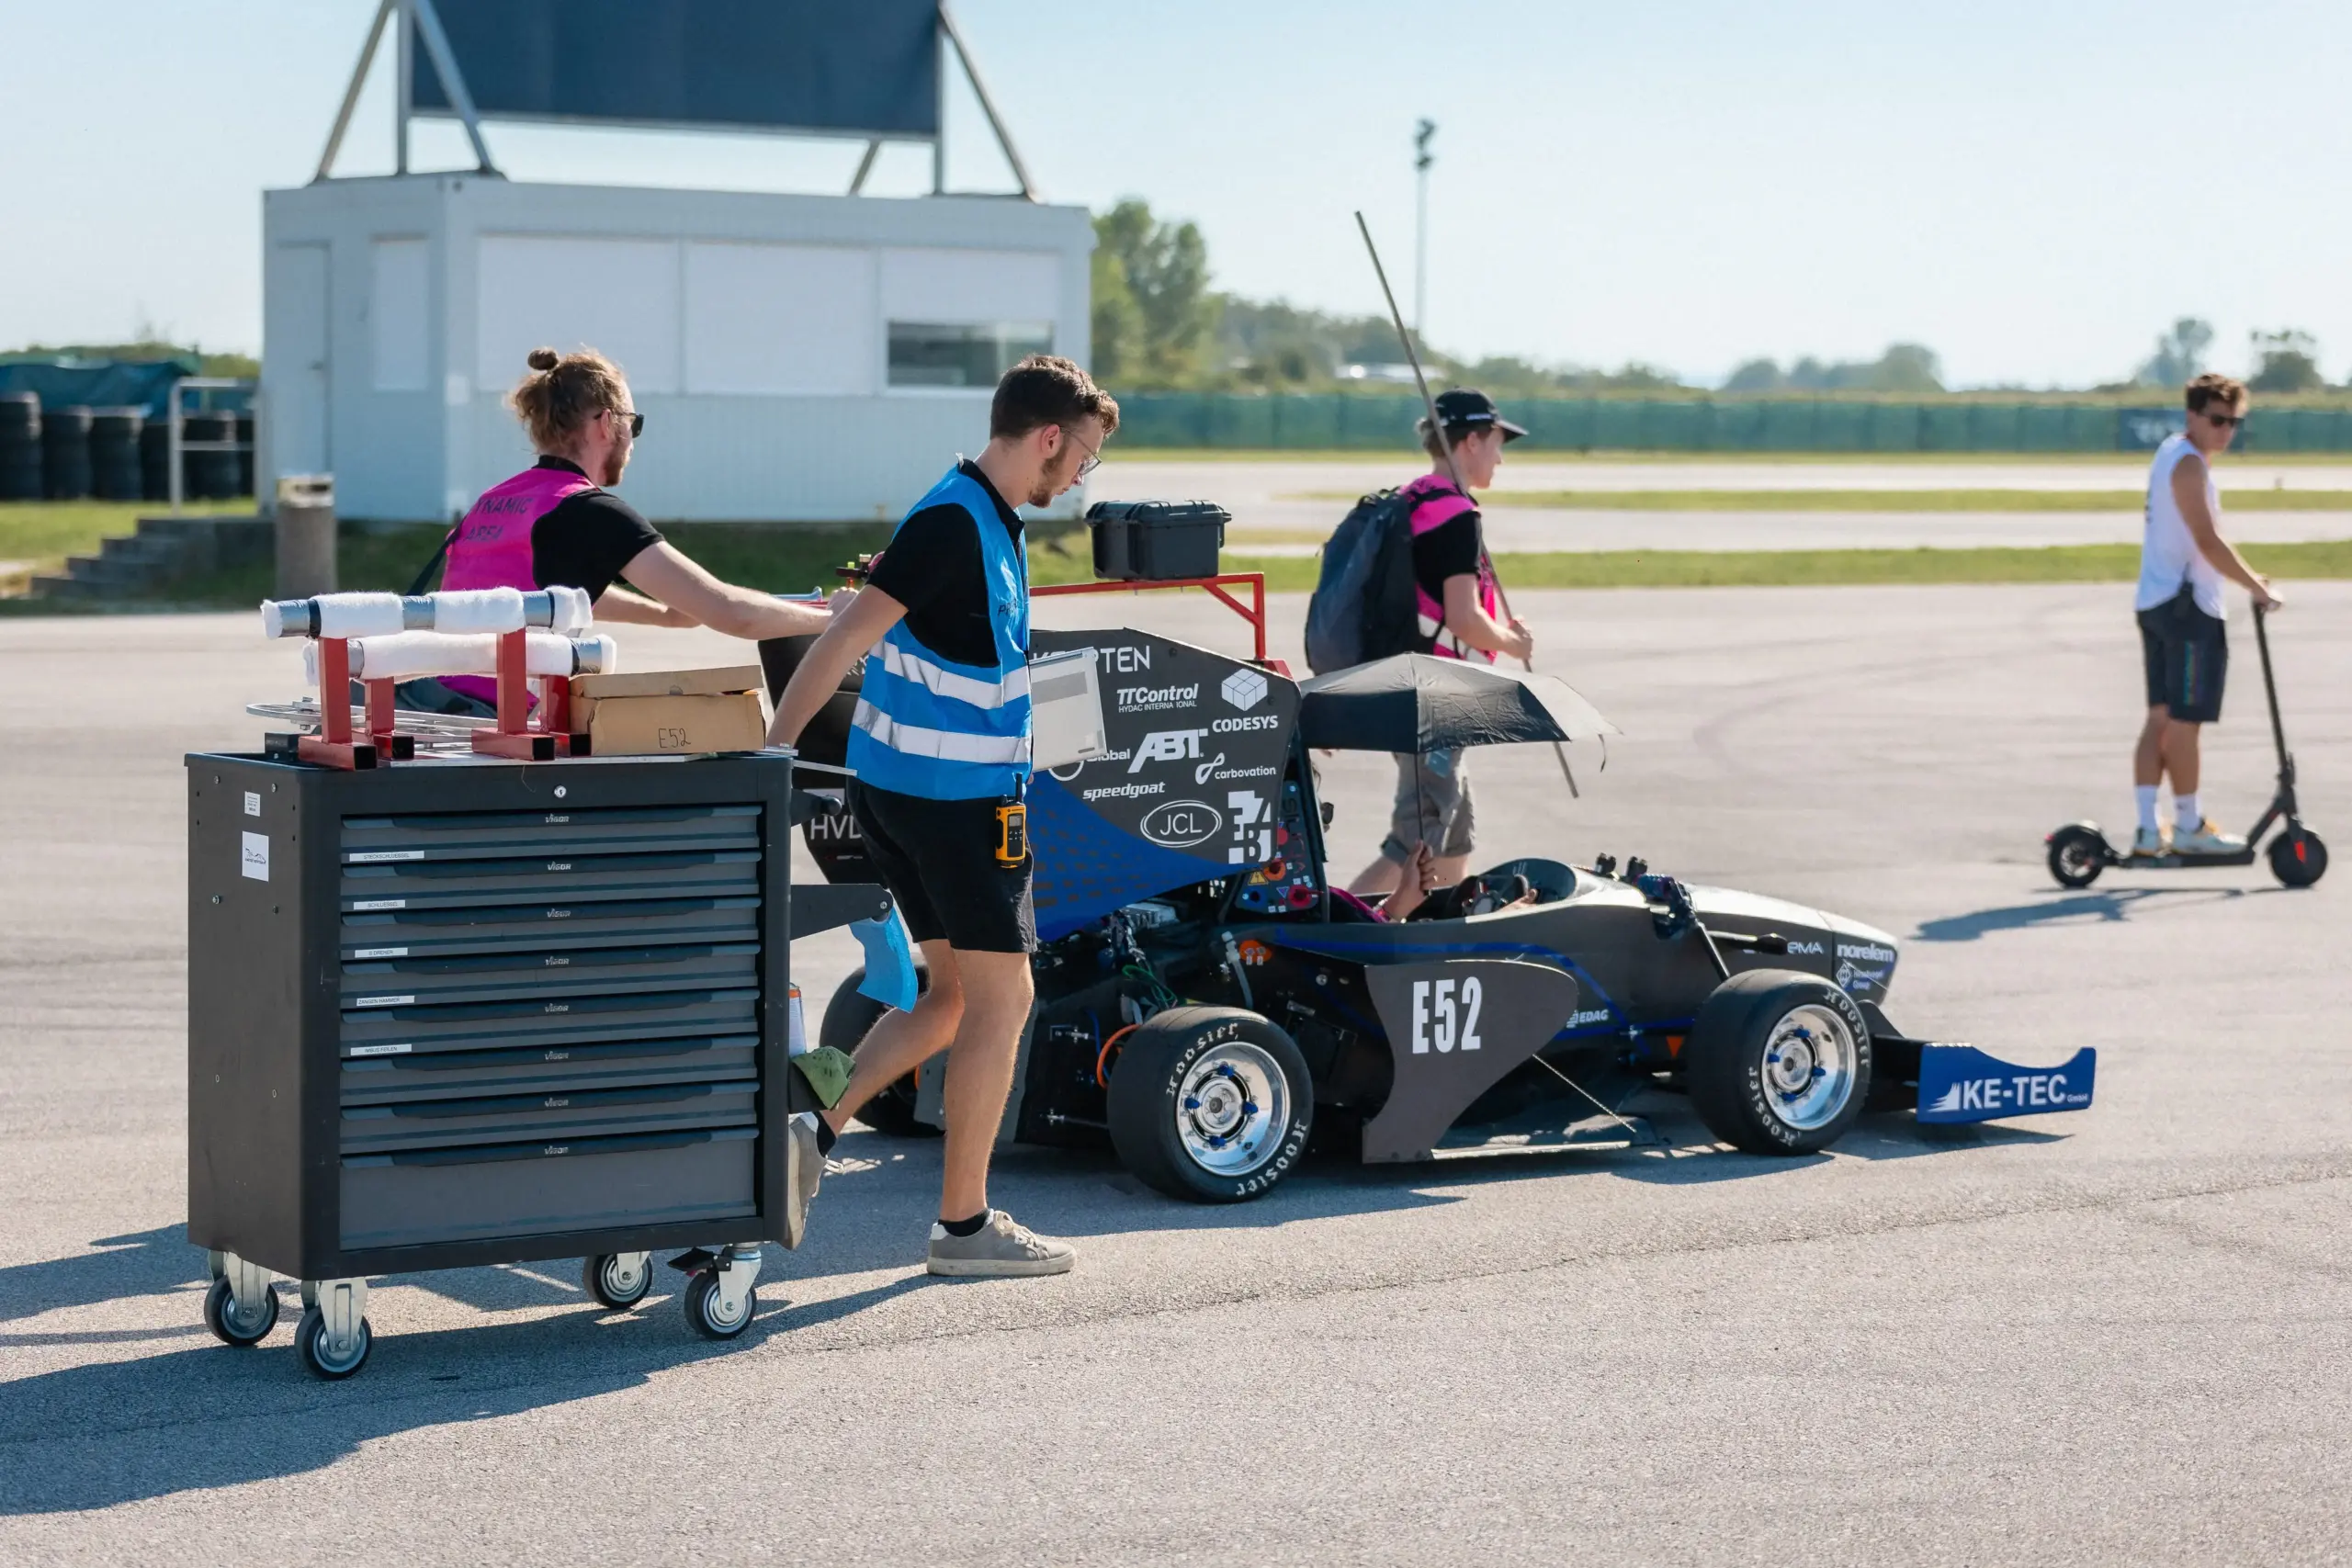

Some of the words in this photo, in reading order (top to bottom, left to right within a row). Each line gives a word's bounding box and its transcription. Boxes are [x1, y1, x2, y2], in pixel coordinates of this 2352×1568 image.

[476, 496, 533, 514] YNAMIC
[463, 525, 503, 542] AREA
[1117, 682, 1199, 705] TTControl
[1118, 704, 1144, 714] HYDAC
[1212, 715, 1279, 733] CODESYS
[658, 728, 692, 749] E52
[1127, 728, 1209, 773] ABT
[1214, 765, 1277, 780] carbovation
[1082, 781, 1166, 802] speedgoat
[1159, 814, 1203, 836] JCL
[1838, 942, 1894, 964] norelem
[1412, 976, 1482, 1054] E52
[1578, 1009, 1609, 1023] EDAG
[1166, 1022, 1239, 1097] Hoosier
[1962, 1074, 2067, 1110] KE-TEC
[1236, 1118, 1308, 1197] Hoosier
